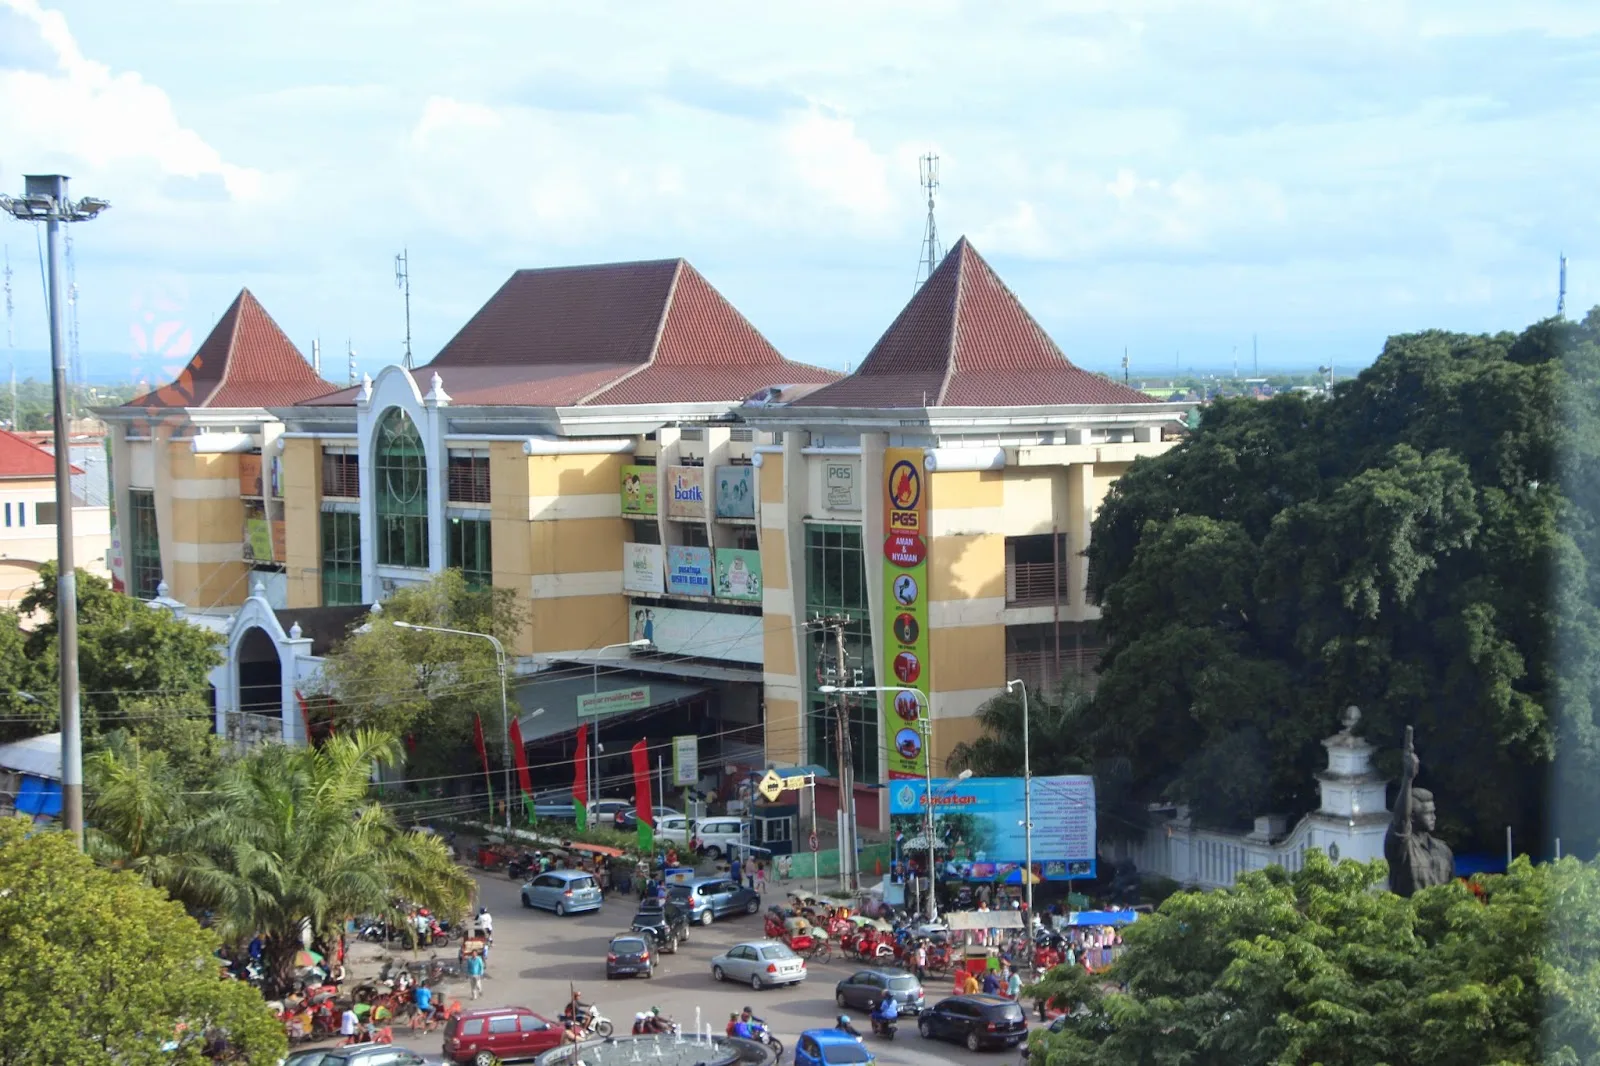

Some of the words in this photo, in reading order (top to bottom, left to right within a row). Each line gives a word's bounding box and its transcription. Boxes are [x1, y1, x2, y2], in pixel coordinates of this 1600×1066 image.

[829, 467, 851, 479] PGS
[674, 485, 703, 501] batik
[892, 512, 918, 526] PGS
[896, 537, 914, 546] AMAN
[892, 552, 918, 563] NYAMAN
